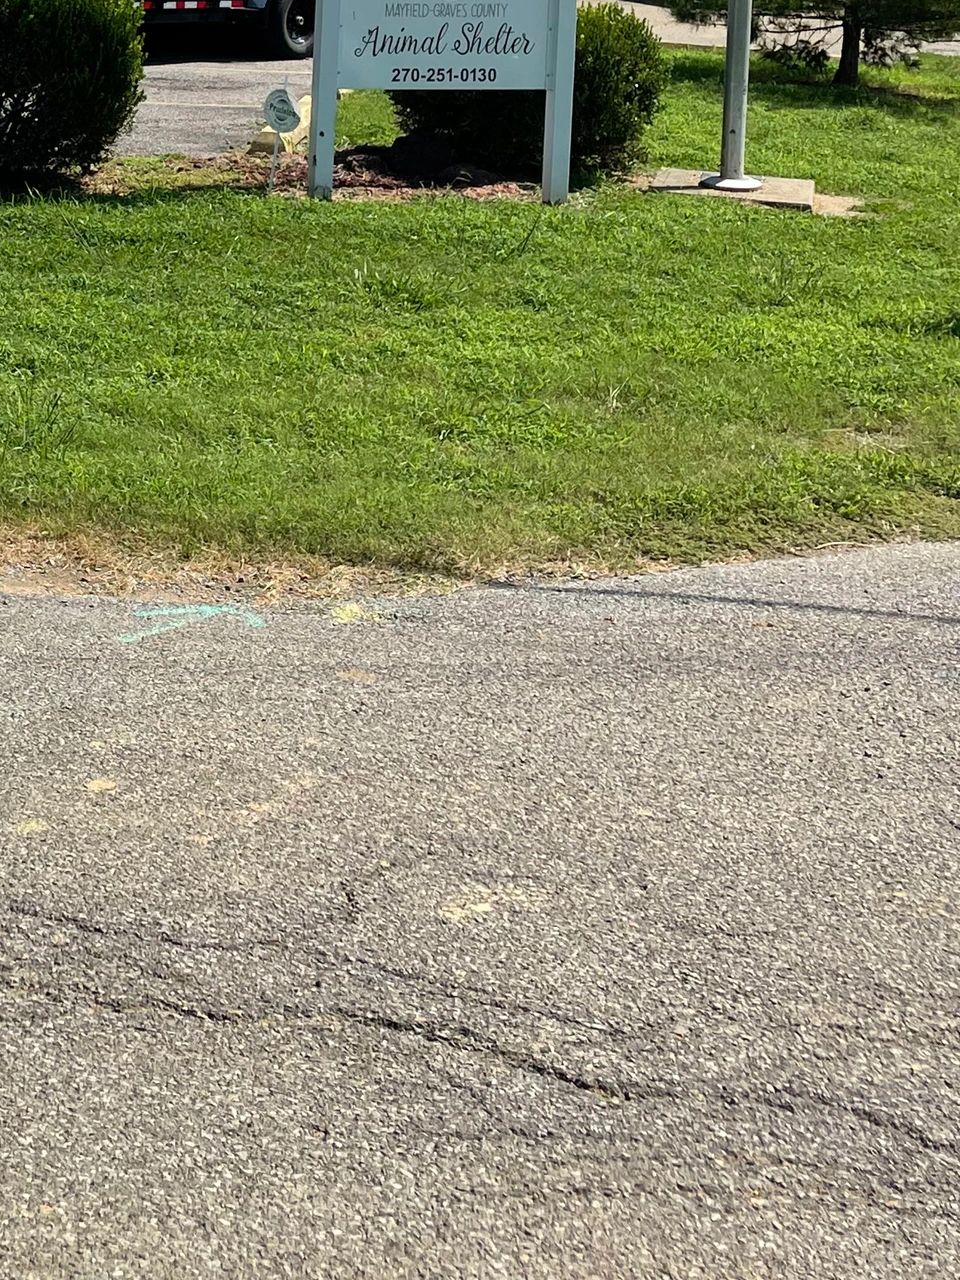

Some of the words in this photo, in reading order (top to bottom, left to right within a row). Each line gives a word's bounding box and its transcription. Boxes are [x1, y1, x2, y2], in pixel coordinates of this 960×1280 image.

[384, 3, 468, 18] MAYFIELD-GRAVES
[470, 3, 509, 18] COUNTY
[354, 22, 449, 58] Animal
[451, 21, 536, 56] Shelter
[391, 67, 497, 83] 270-251-0130
